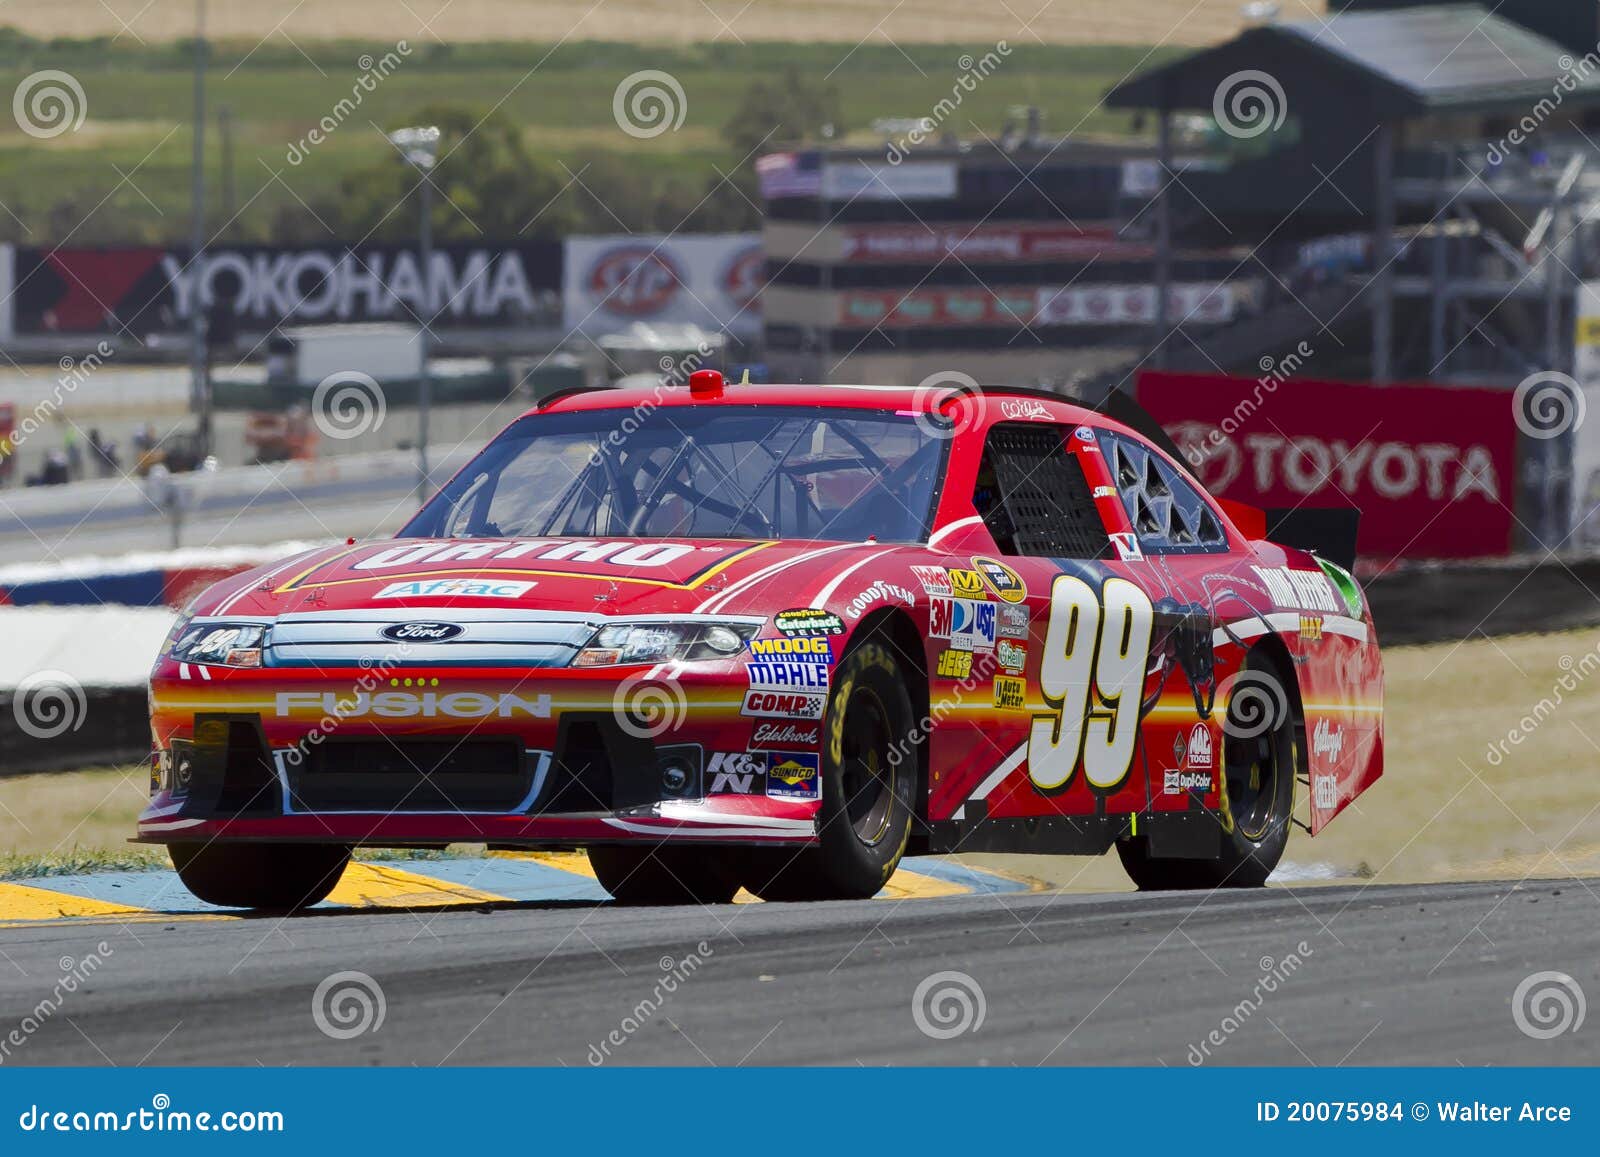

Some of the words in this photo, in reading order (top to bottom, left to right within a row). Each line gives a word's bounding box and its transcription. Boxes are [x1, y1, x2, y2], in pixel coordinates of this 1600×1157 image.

[162, 251, 535, 317] YOKOHAMA
[1243, 432, 1500, 502] TOYOTA
[352, 541, 696, 568] ORTHO
[846, 580, 915, 619] GOODYEAR
[775, 616, 841, 630] Gatorback
[930, 599, 951, 637] 3M
[976, 603, 995, 642] USG
[396, 624, 450, 638] Ford
[785, 627, 842, 636] BELTS
[751, 637, 828, 654] MOOG
[748, 663, 827, 686] MAHLE
[1029, 574, 1154, 794] 99
[1002, 680, 1020, 693] Auto
[276, 692, 551, 718] FUSION
[747, 693, 807, 711] COMP
[754, 723, 818, 744] Edelbrock
[1190, 727, 1210, 754] MAC
[1190, 754, 1210, 763] TOOLS
[771, 766, 815, 778] SUNOCO
